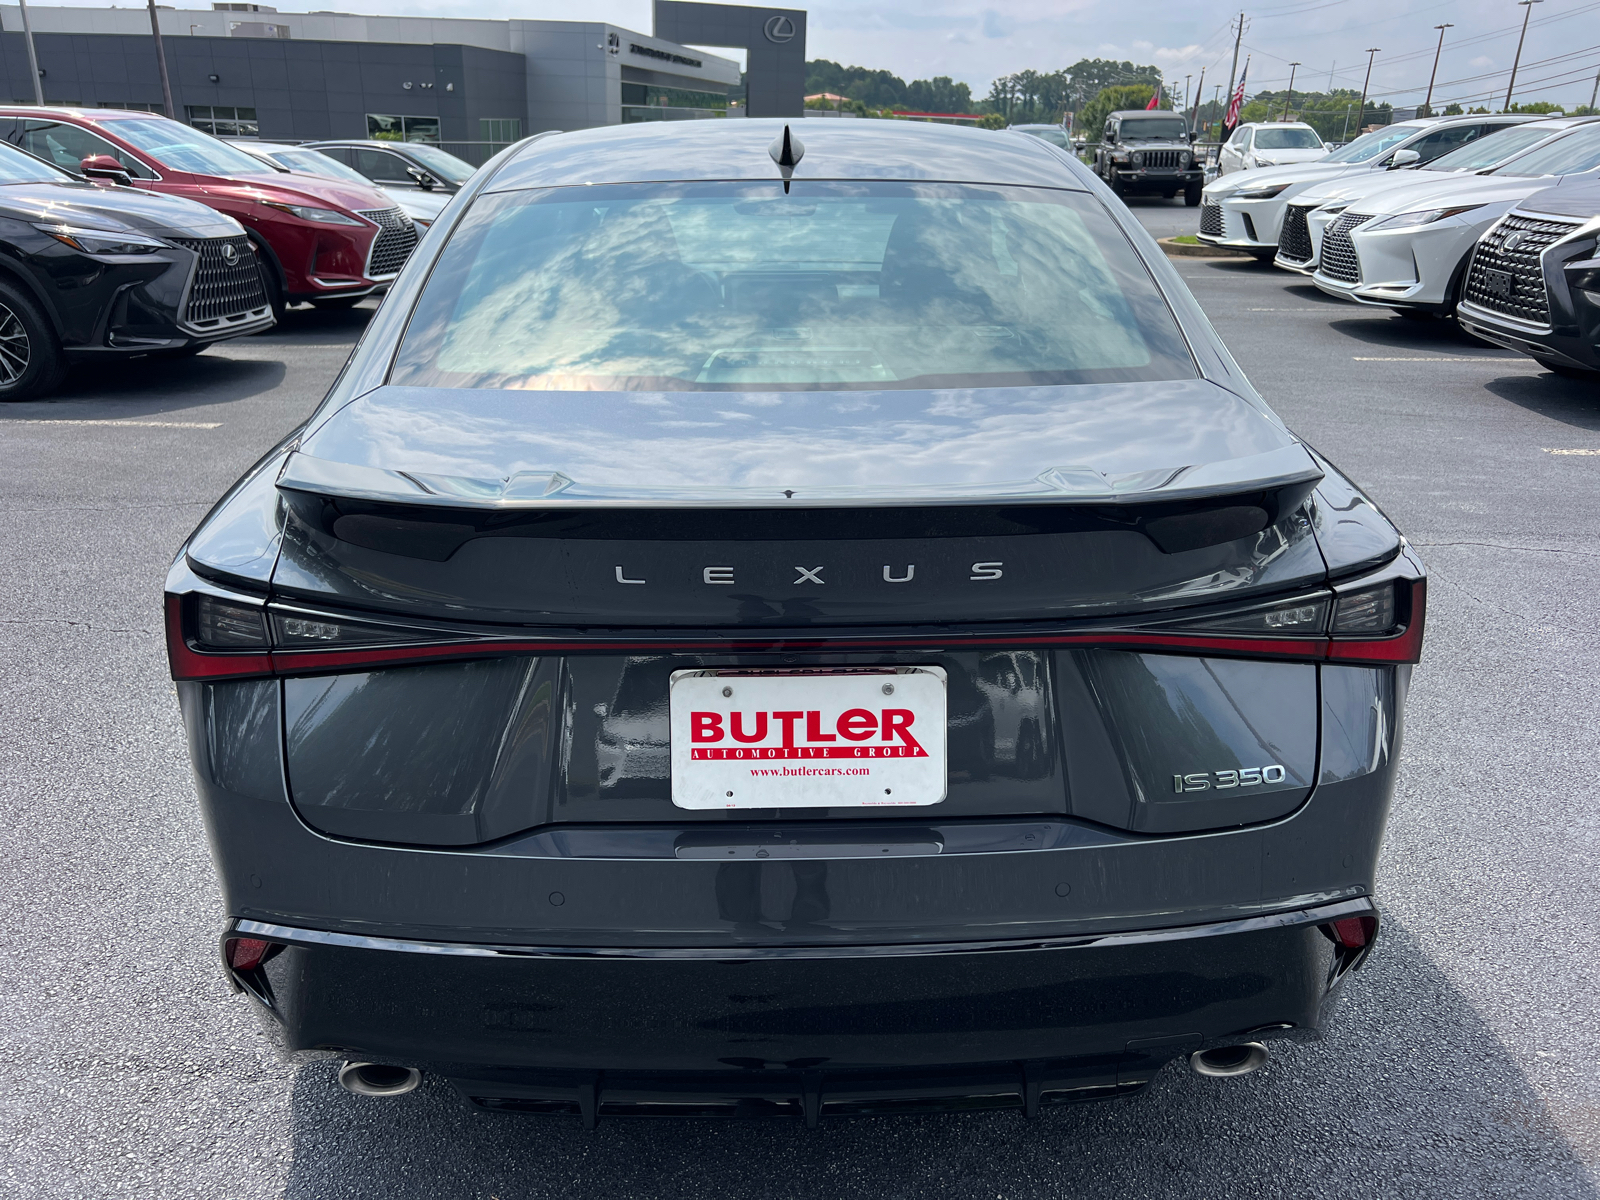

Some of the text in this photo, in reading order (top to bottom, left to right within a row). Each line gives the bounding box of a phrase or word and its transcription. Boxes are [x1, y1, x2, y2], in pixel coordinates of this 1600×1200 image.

[615, 562, 1003, 585] LEXUS
[692, 746, 921, 759] AUTOMOTIVE GROUP
[750, 766, 870, 777] www.butlercars.com
[1173, 764, 1286, 793] IS 350
